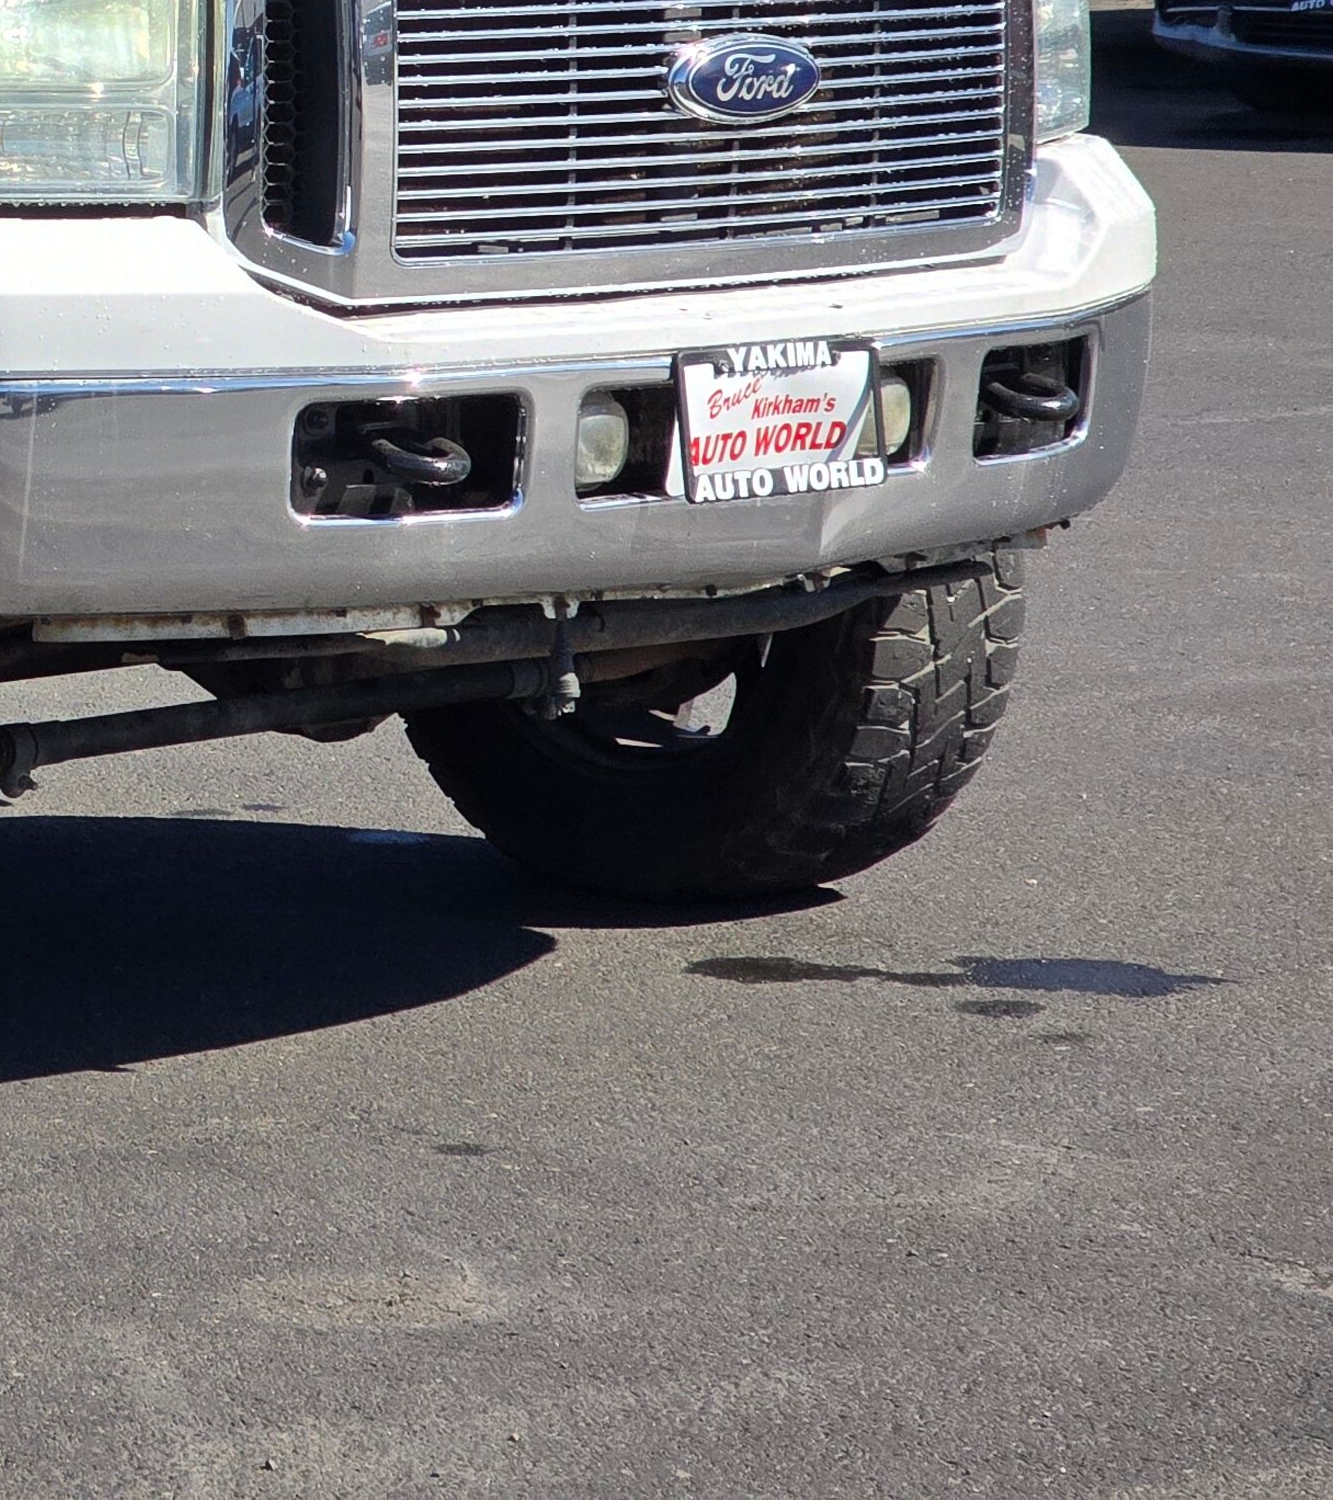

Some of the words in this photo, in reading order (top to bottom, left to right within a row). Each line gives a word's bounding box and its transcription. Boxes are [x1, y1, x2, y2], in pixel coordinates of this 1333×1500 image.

[716, 53, 795, 102] Ford
[727, 341, 832, 372] YAKIMA
[707, 375, 763, 419] Bruce
[751, 392, 836, 420] Kirkham's
[690, 430, 747, 466] AUTO
[753, 421, 847, 457] WORLD
[695, 469, 774, 503] AUTO
[783, 458, 884, 493] WORLD
